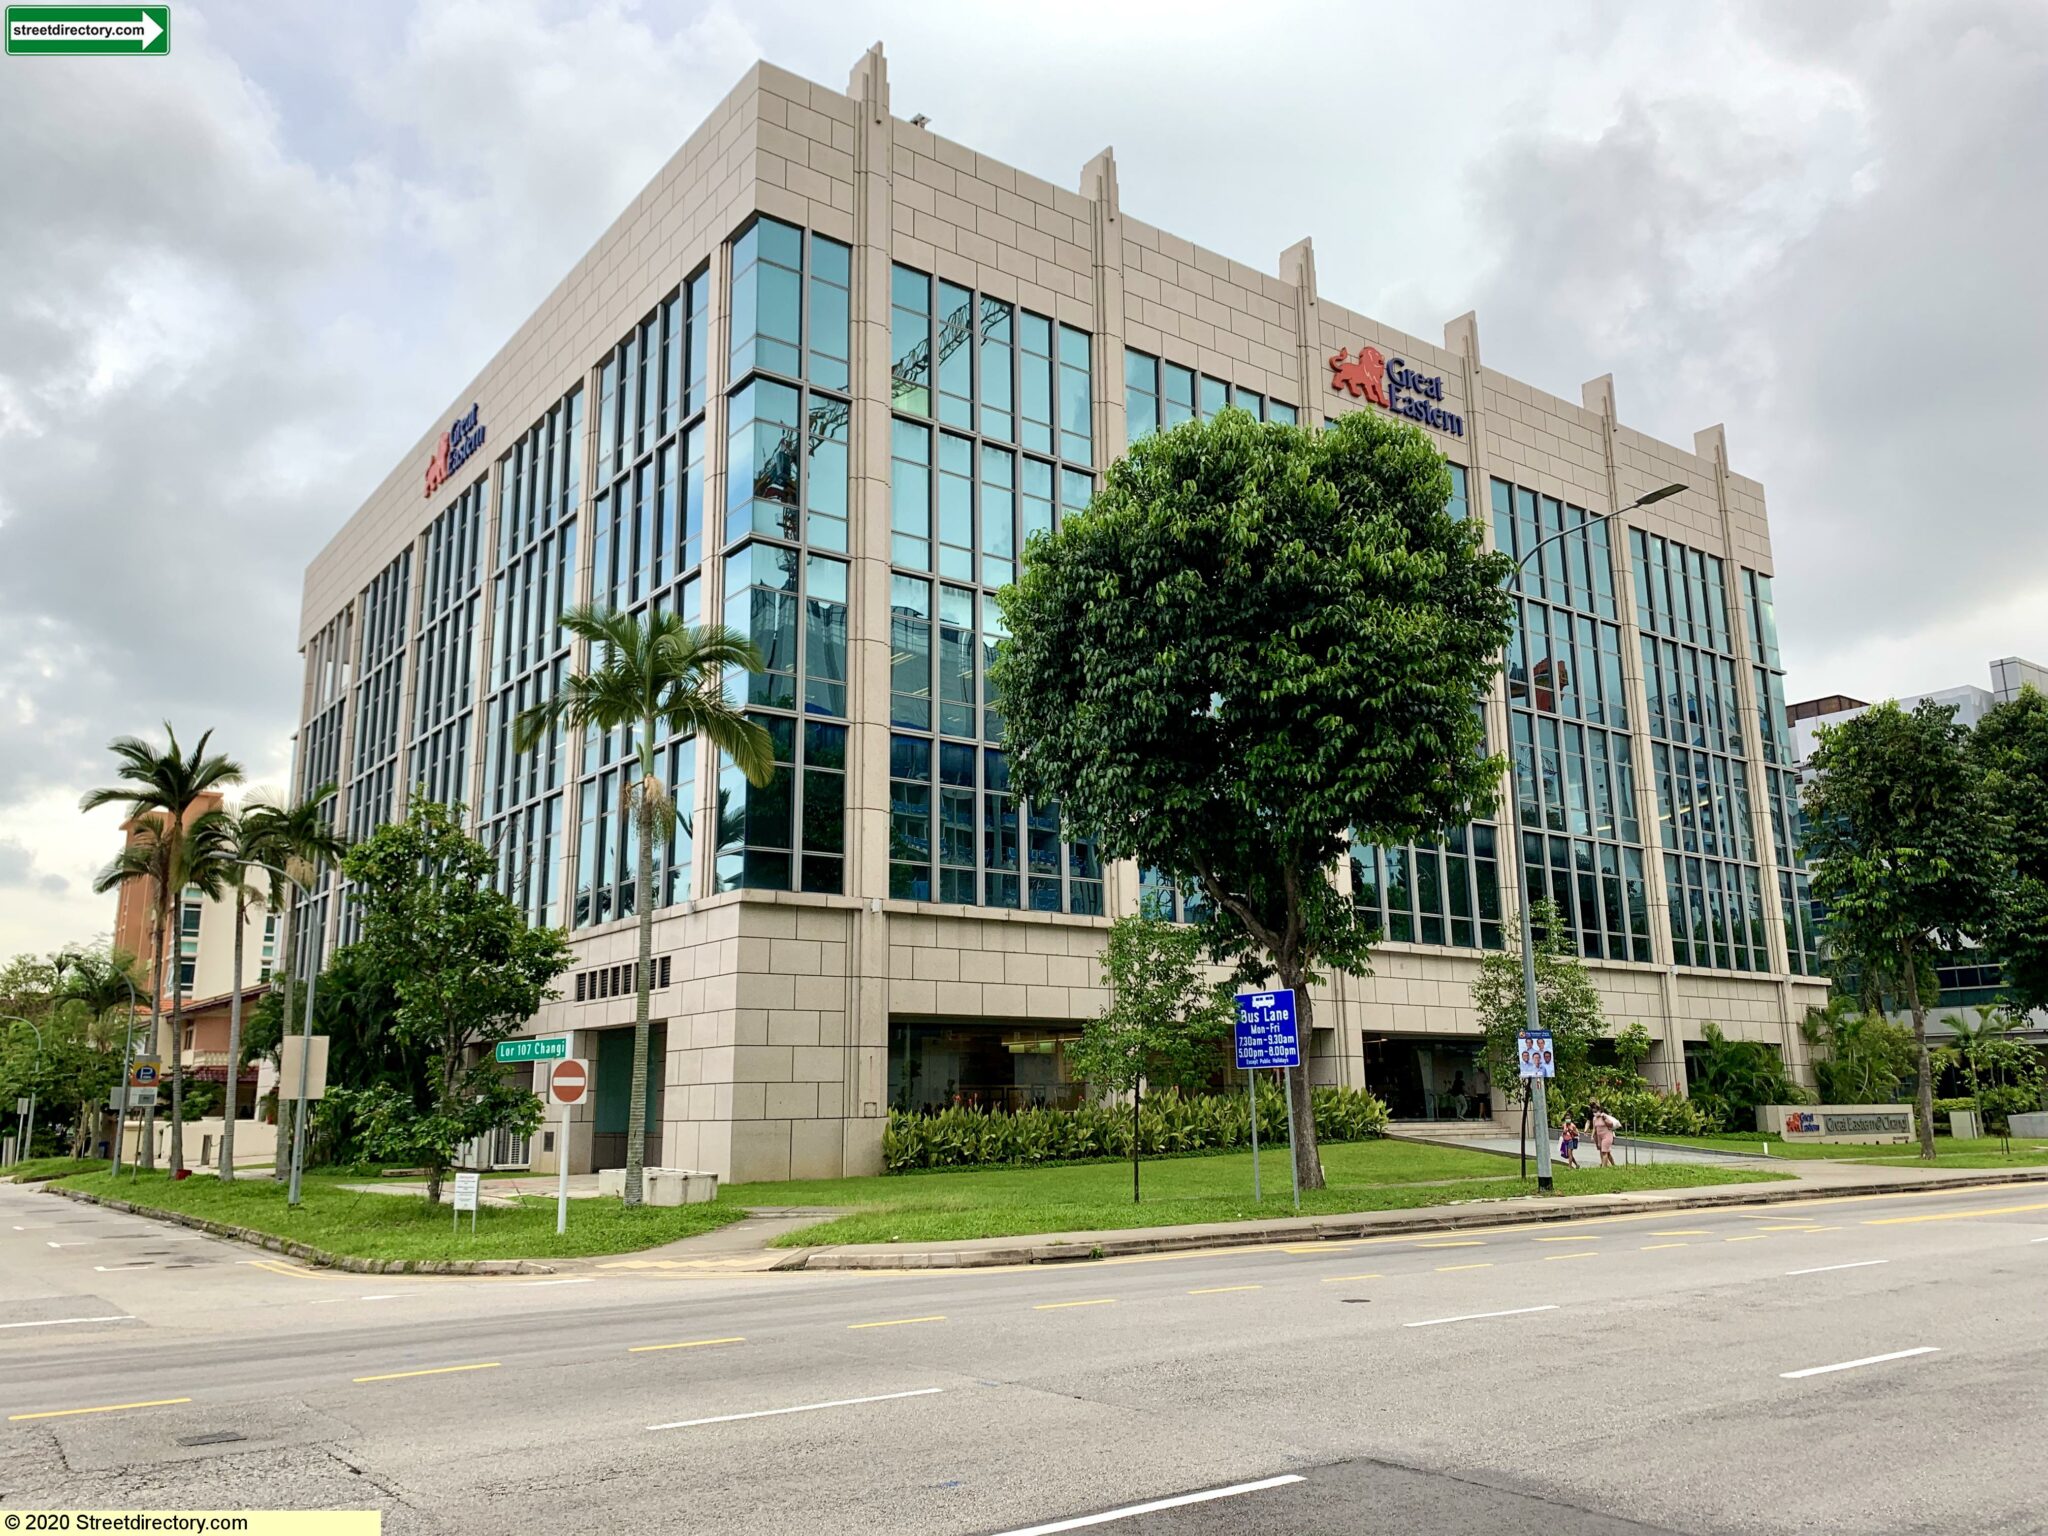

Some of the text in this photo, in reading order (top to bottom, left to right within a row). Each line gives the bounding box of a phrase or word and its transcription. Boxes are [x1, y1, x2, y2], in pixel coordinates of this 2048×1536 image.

[1386, 357, 1445, 401] Great
[1388, 383, 1464, 437] Eastern
[1240, 1007, 1289, 1024] Bus Lane
[1250, 1022, 1280, 1034] Mon-Fri
[500, 1040, 565, 1057] Lor 107 Changi
[1272, 1057, 1289, 1065] Holidays
[1825, 1117, 1847, 1132] Great
